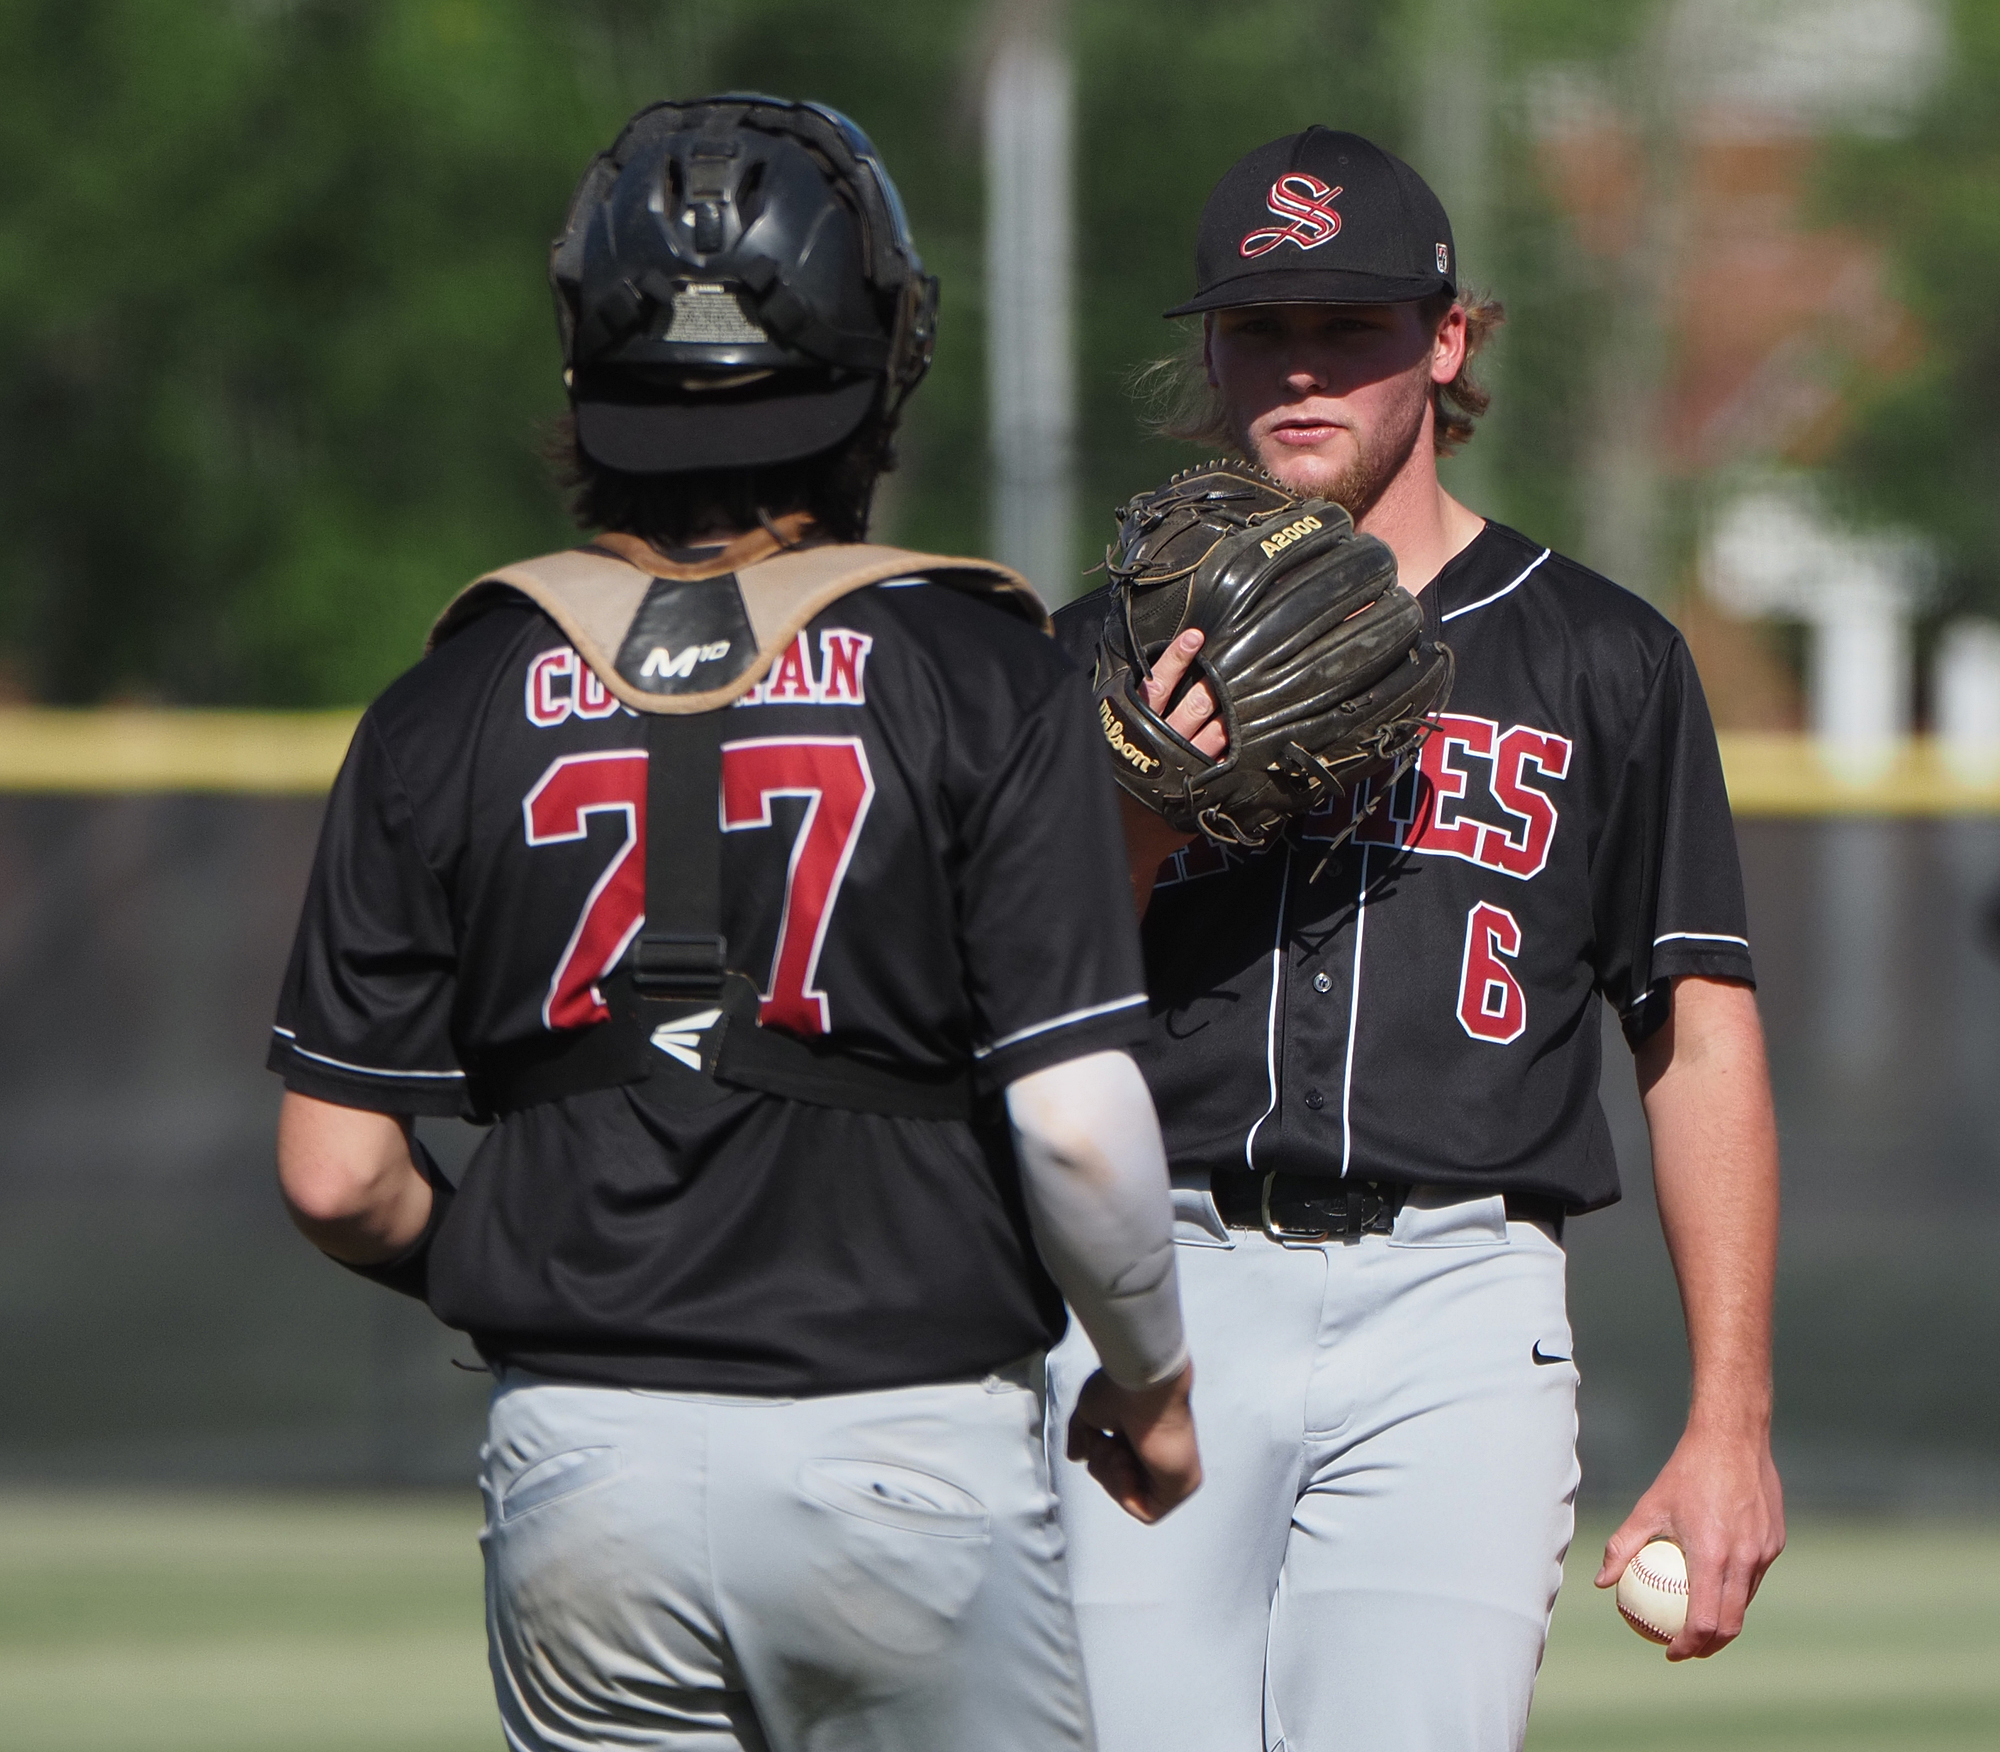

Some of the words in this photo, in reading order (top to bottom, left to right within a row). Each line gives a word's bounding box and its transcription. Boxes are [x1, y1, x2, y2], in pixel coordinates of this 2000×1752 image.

[1260, 515, 1323, 559] A2000
[522, 735, 875, 1035] 27
[1456, 900, 1526, 1045] 6
